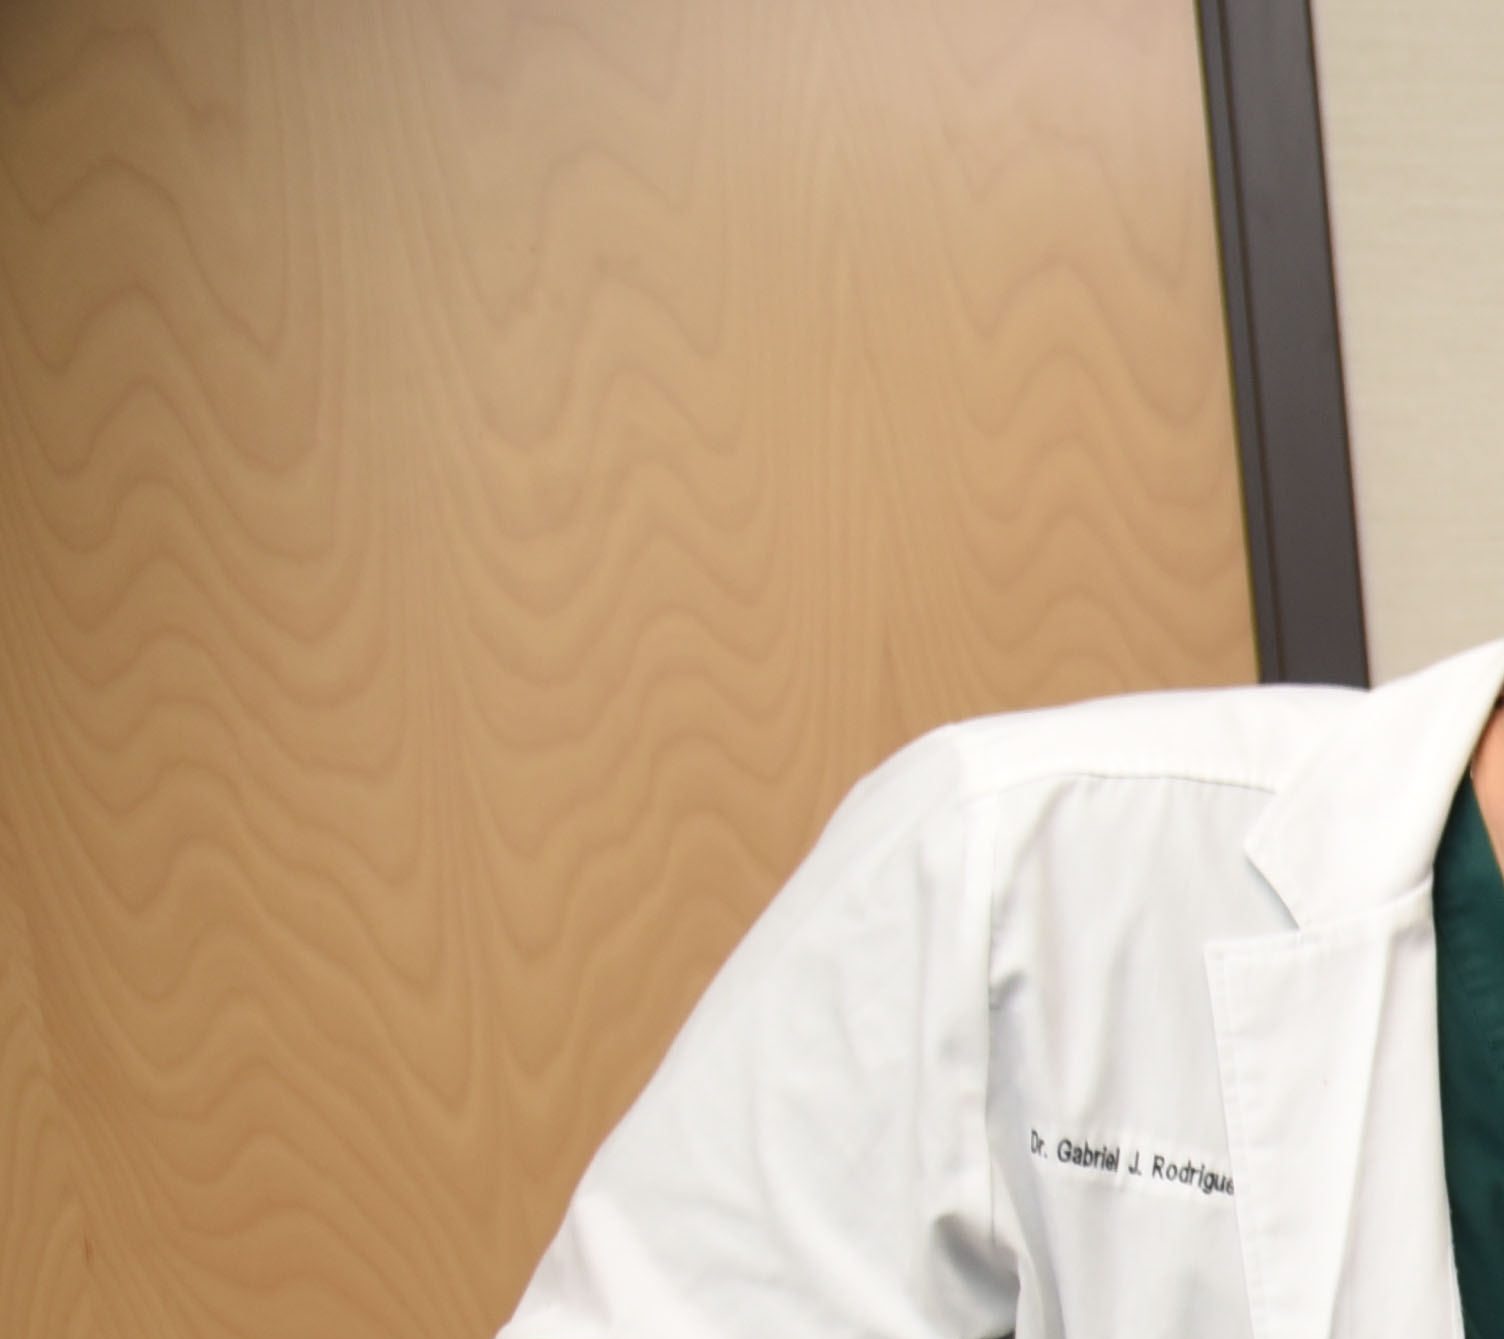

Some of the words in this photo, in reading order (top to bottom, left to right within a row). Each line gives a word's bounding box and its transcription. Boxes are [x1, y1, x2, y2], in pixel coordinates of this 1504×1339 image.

[1031, 1128, 1048, 1159] Dr.
[1057, 1138, 1120, 1173] Gabriel
[1128, 1151, 1142, 1176] J.
